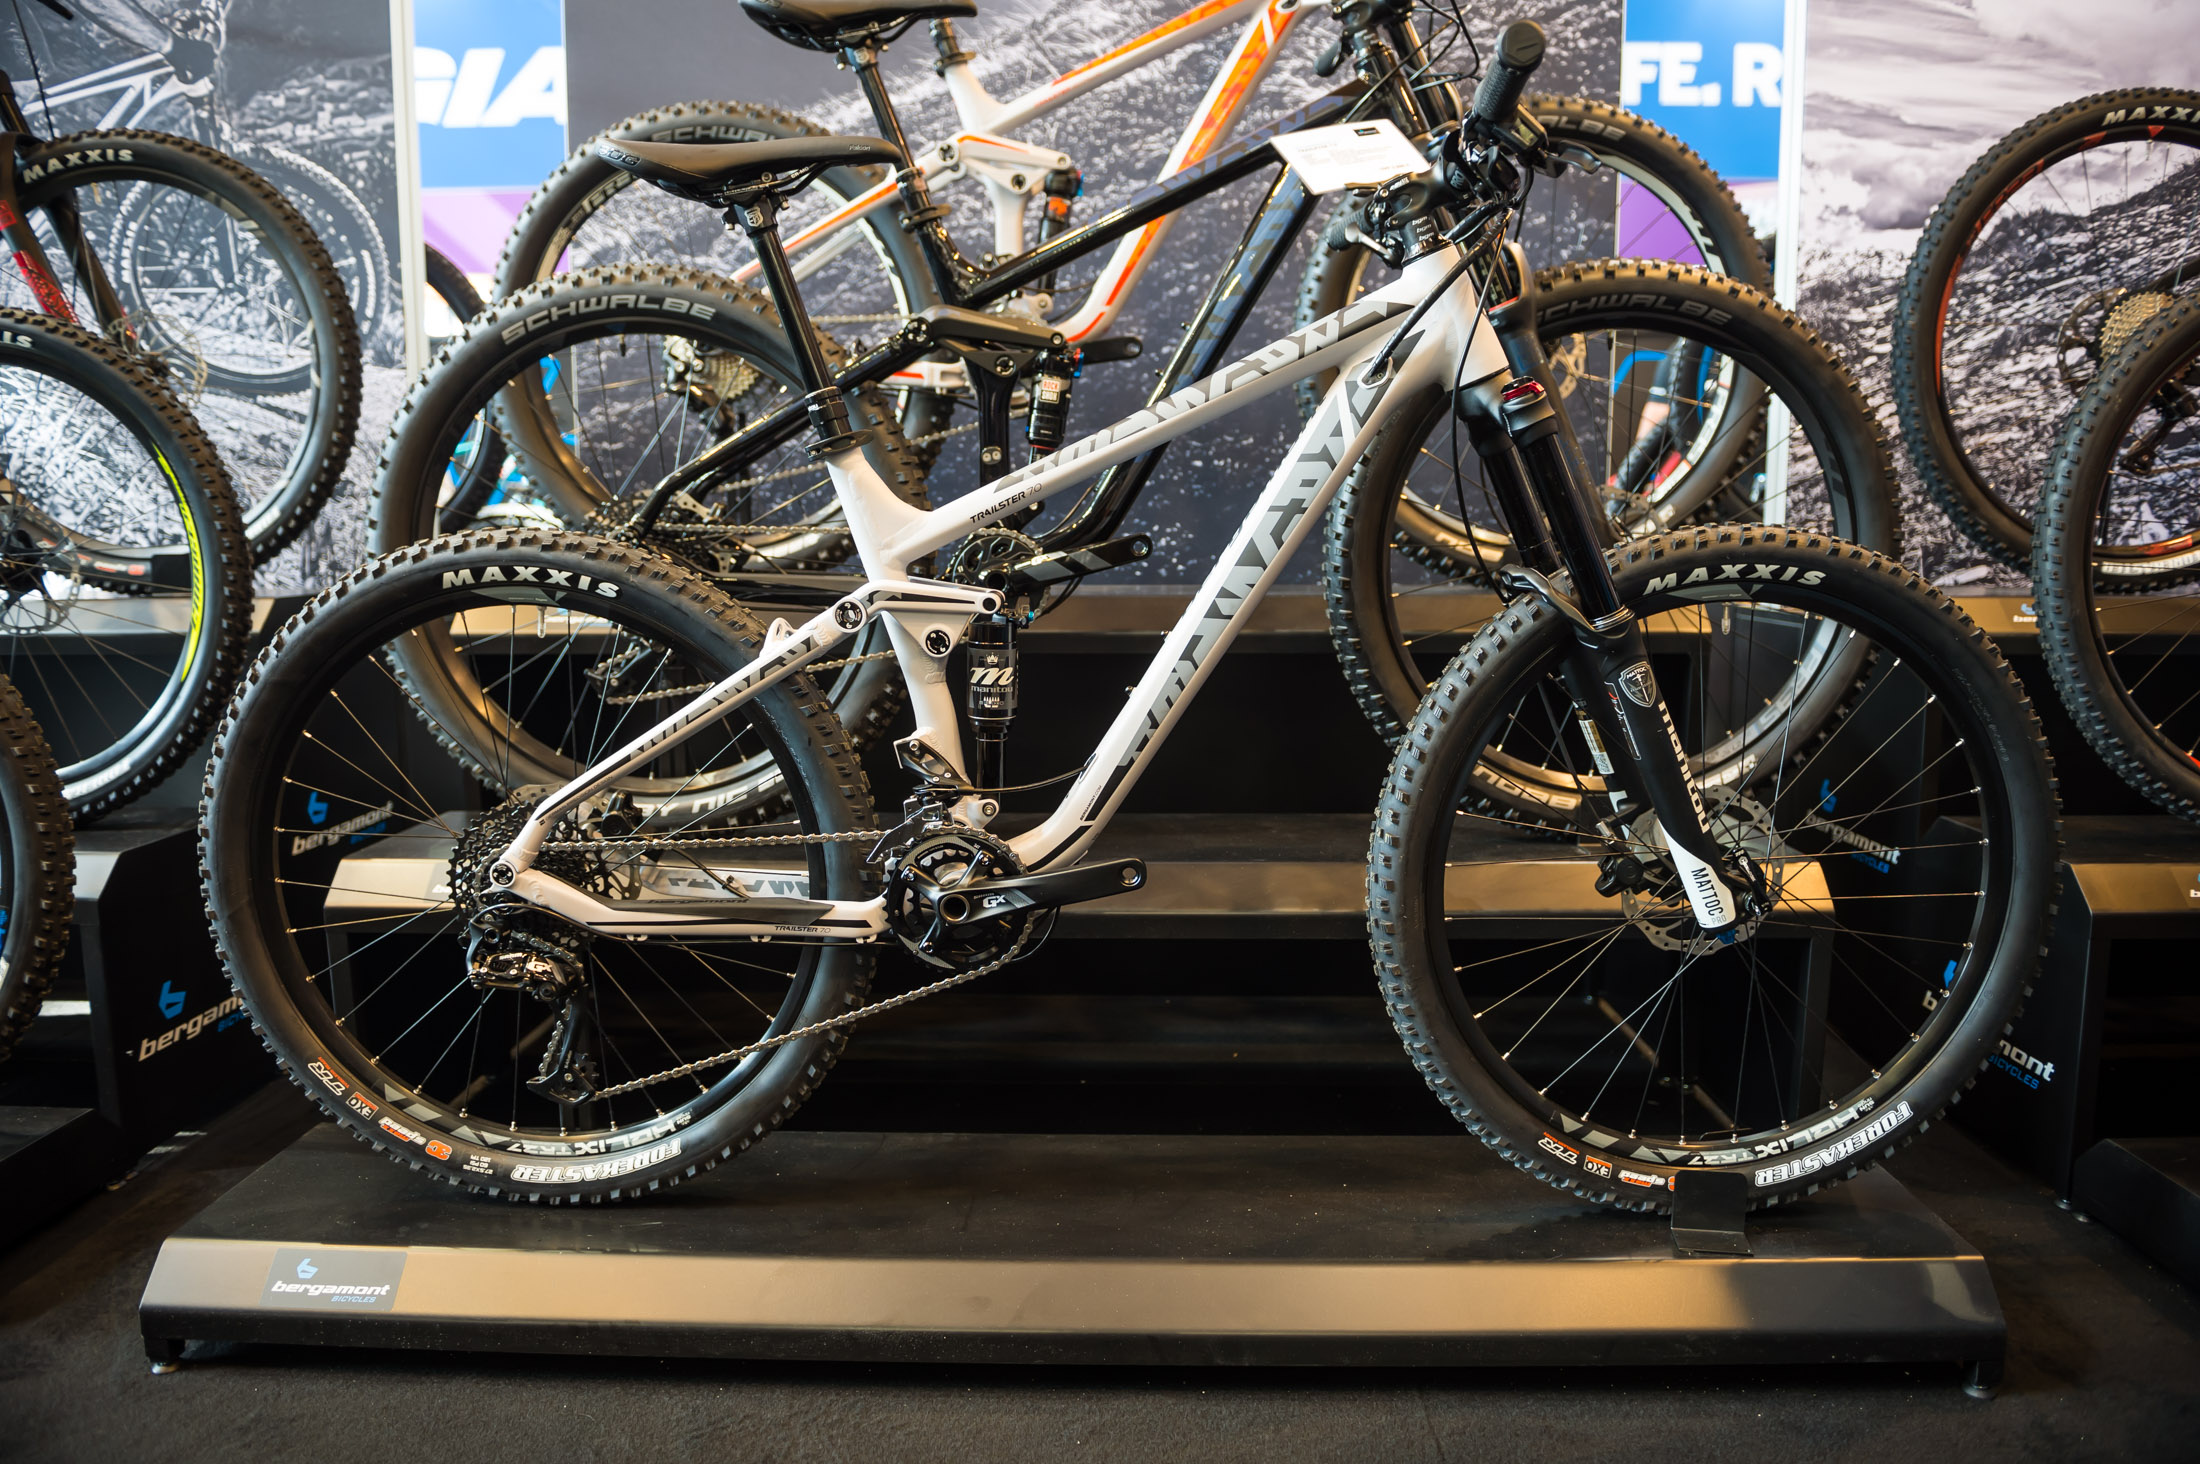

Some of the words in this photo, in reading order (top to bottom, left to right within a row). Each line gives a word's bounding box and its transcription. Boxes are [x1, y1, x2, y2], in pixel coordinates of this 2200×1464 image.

[22, 148, 134, 184] MAXXIS
[501, 294, 717, 346] SCHWALBE
[970, 491, 1026, 524] TRAILSTER
[443, 566, 620, 598] MAXXIS
[1642, 563, 1826, 596] MAXXIS
[971, 685, 1013, 693] manitou
[1658, 700, 1711, 834] manitou
[982, 894, 1006, 909] GX
[1691, 866, 1724, 916] MATTOC
[775, 925, 818, 933] TRAILSTER
[1712, 913, 1728, 926] PRO
[349, 1096, 374, 1120] EXO
[1755, 1101, 1914, 1187] FOREKASTER
[510, 1138, 682, 1184] FOREKASTER
[1585, 1161, 1610, 1178] EXO
[271, 1280, 390, 1296] bergamont
[331, 1295, 376, 1303] BICYCLES
